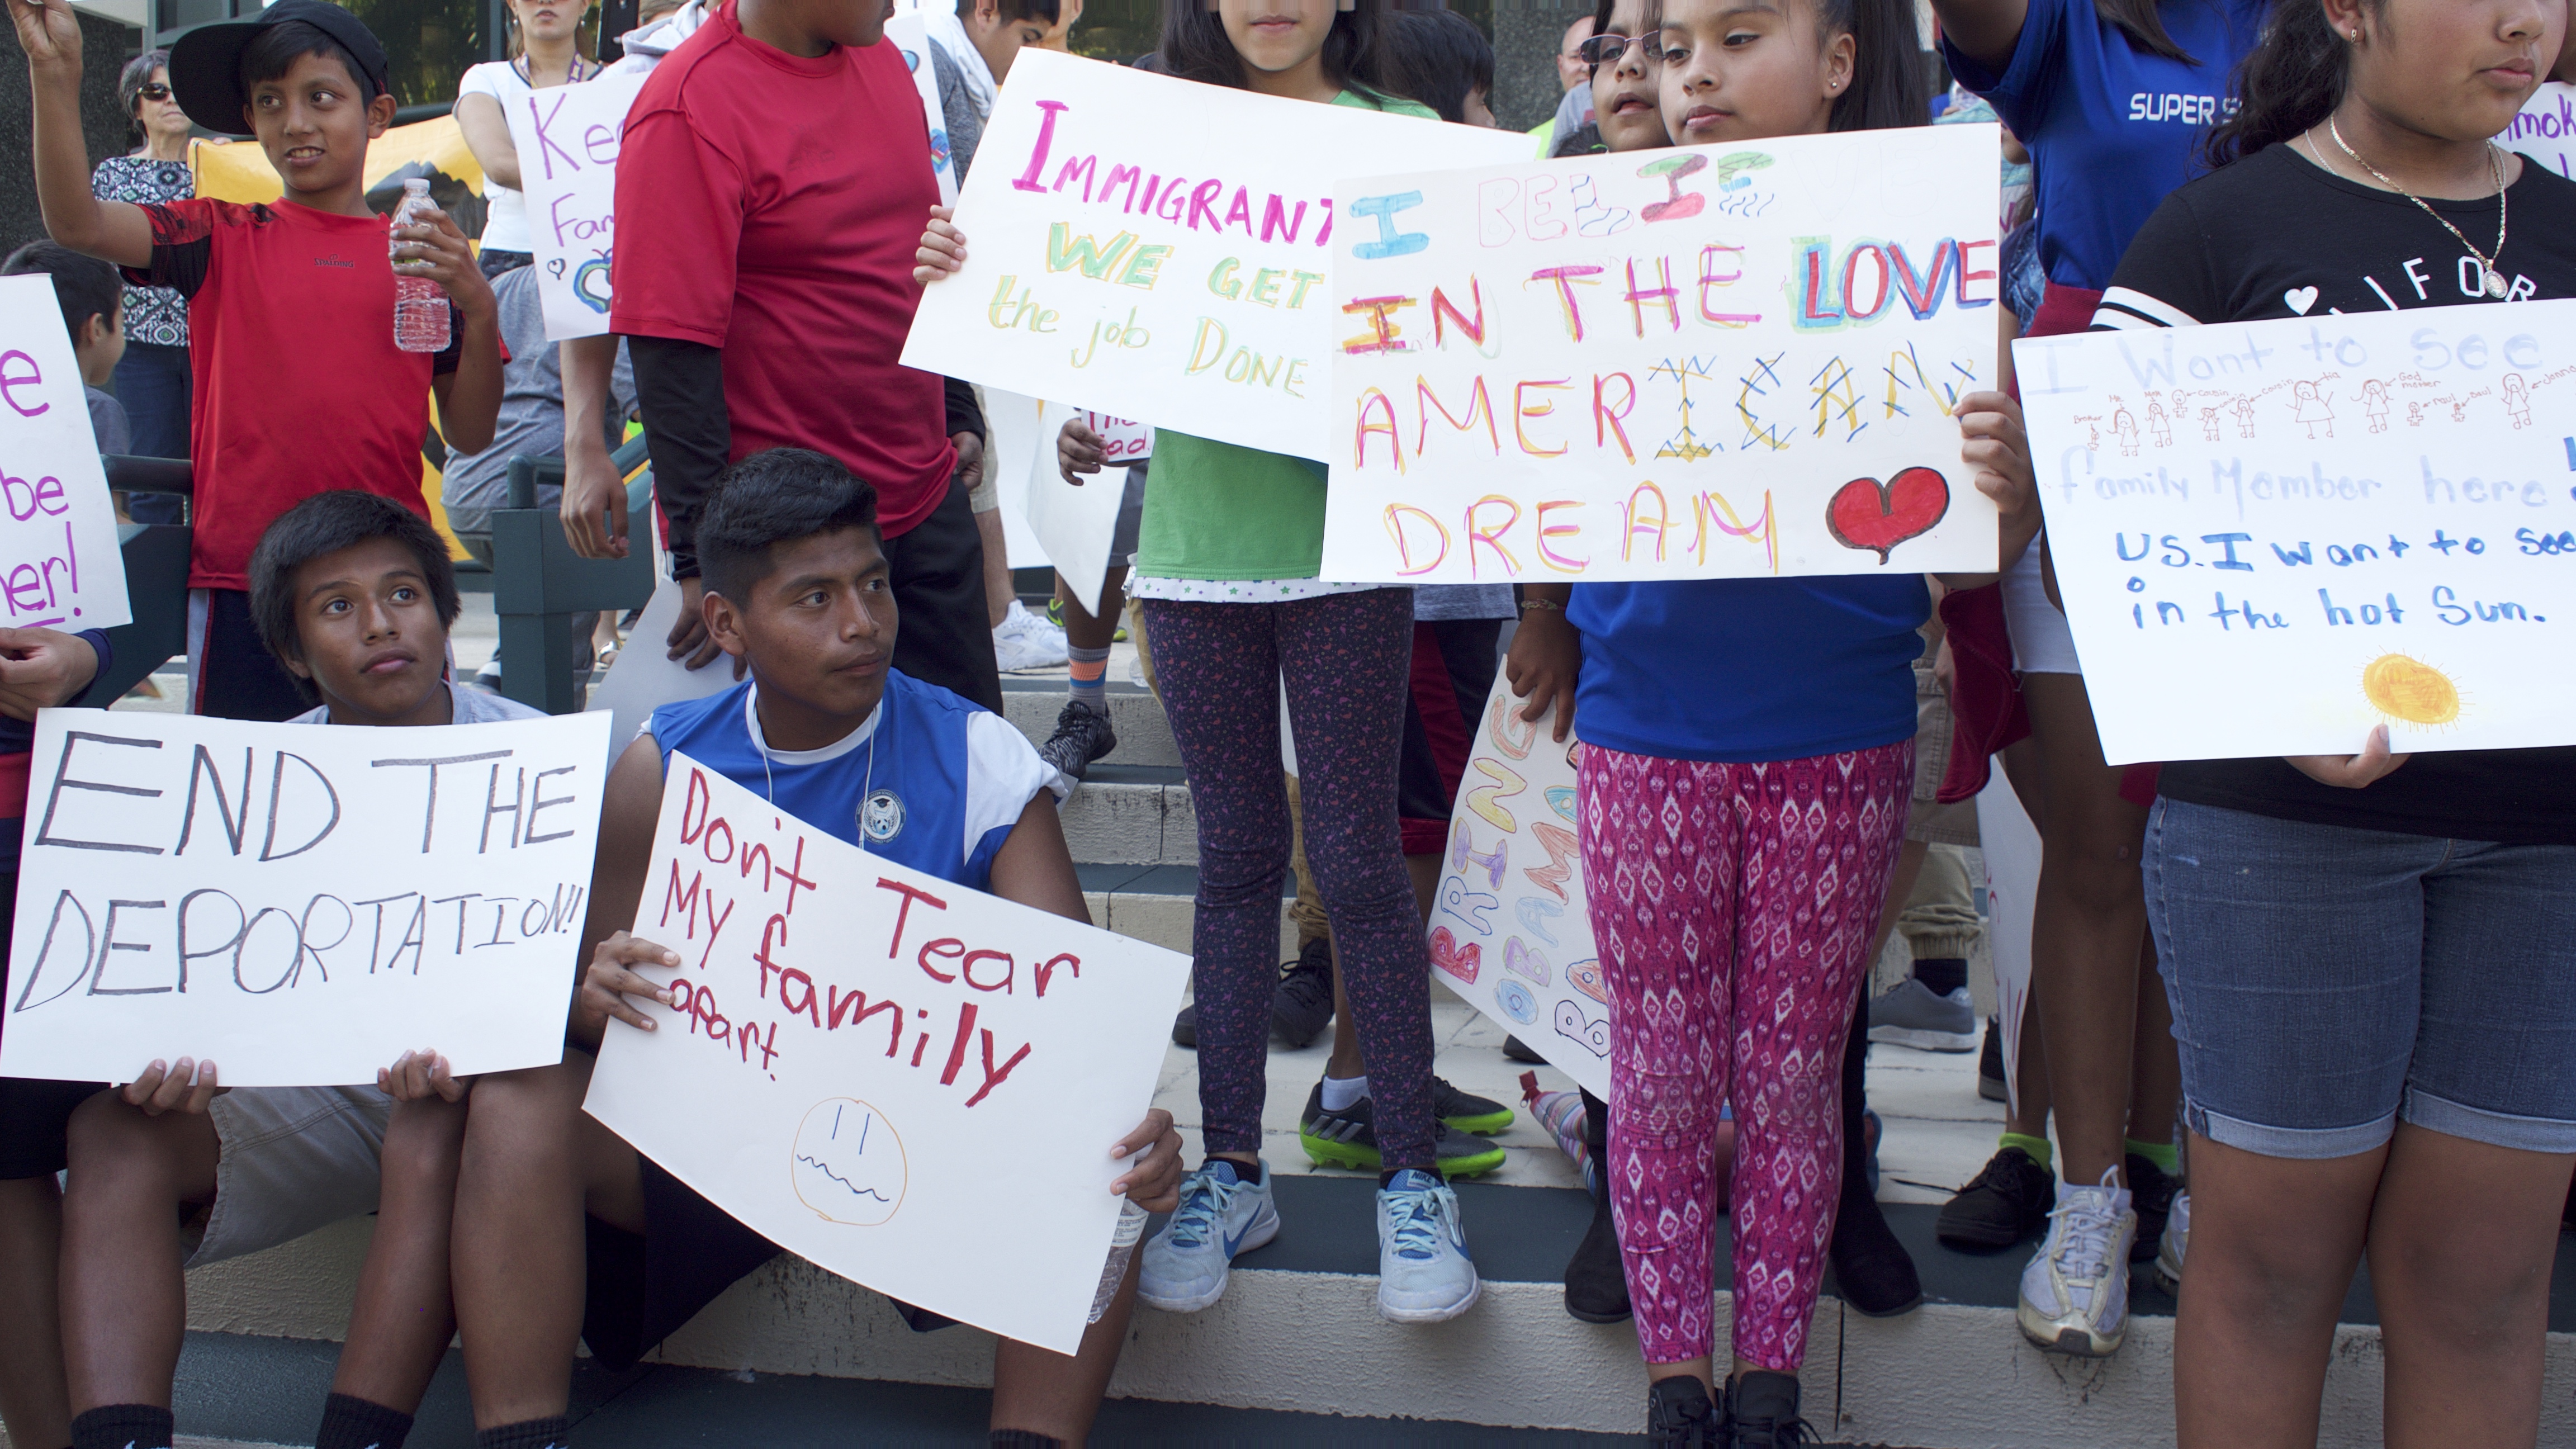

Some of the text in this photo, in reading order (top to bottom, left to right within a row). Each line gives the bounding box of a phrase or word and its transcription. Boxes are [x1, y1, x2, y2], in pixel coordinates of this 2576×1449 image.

[2129, 93, 2215, 125] SUPER
[314, 258, 354, 268] SPALDING
[1046, 222, 1325, 309] WE GET
[1349, 190, 1429, 259] I
[988, 276, 1059, 333] the
[1071, 305, 1150, 369] job
[1342, 235, 1996, 358] IN THE LOVE
[2018, 338, 2089, 395] I
[2116, 329, 2274, 390] Want
[2300, 325, 2367, 368] to
[1355, 340, 1976, 476] AMERICAN
[0, 468, 69, 521] be
[2059, 445, 2549, 523] family Member here
[1383, 481, 1778, 580] DREAM
[2271, 534, 2409, 567] want
[2428, 529, 2485, 555] to
[2127, 577, 2185, 629] in
[2208, 591, 2289, 630] the
[2317, 588, 2405, 626] hot
[35, 731, 576, 861] END THE
[1428, 694, 1537, 985] BRING
[680, 767, 1080, 999] Don't Tear
[13, 883, 584, 1014] DEPORTATION!
[660, 858, 1031, 1108] My family
[1411, 1171, 1432, 1183] NIKE
